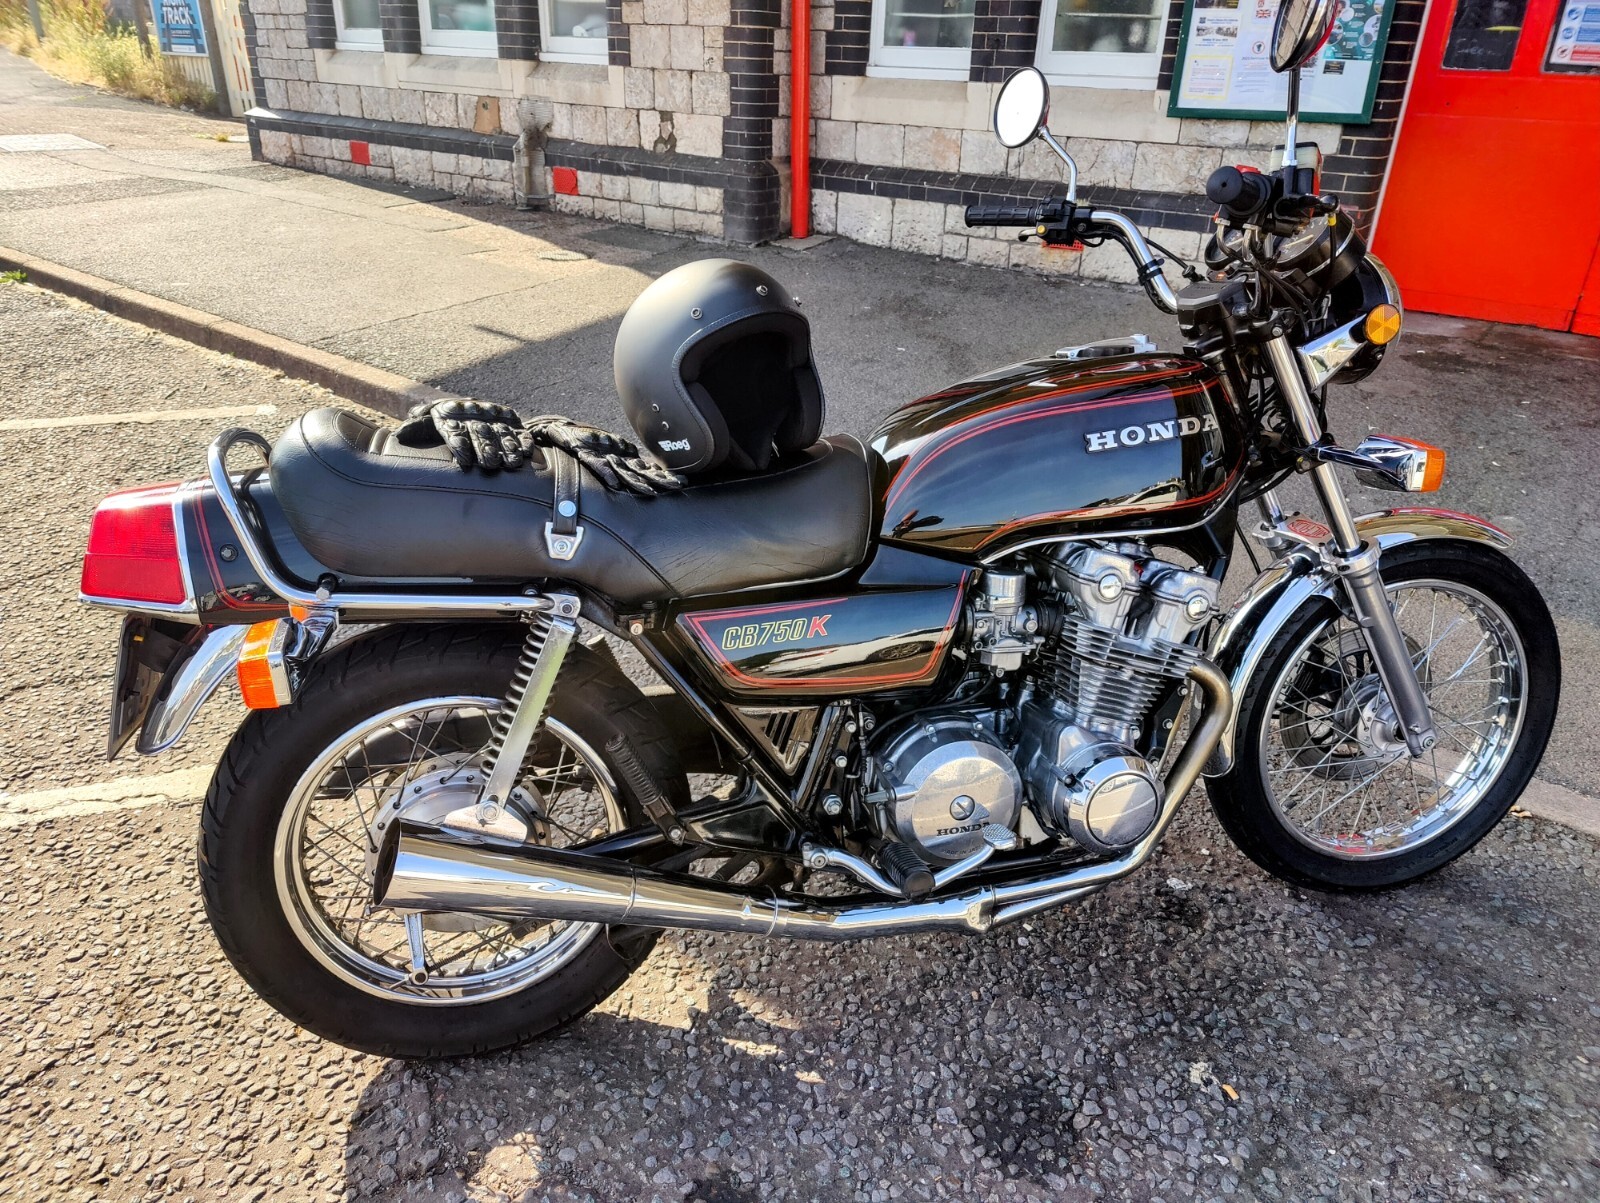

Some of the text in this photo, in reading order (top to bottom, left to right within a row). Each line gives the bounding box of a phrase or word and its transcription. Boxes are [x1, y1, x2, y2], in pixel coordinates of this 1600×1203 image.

[161, 6, 193, 25] TRACK
[662, 438, 691, 452] Roeg
[1085, 413, 1219, 452] HONDA
[721, 614, 832, 651] CB750K
